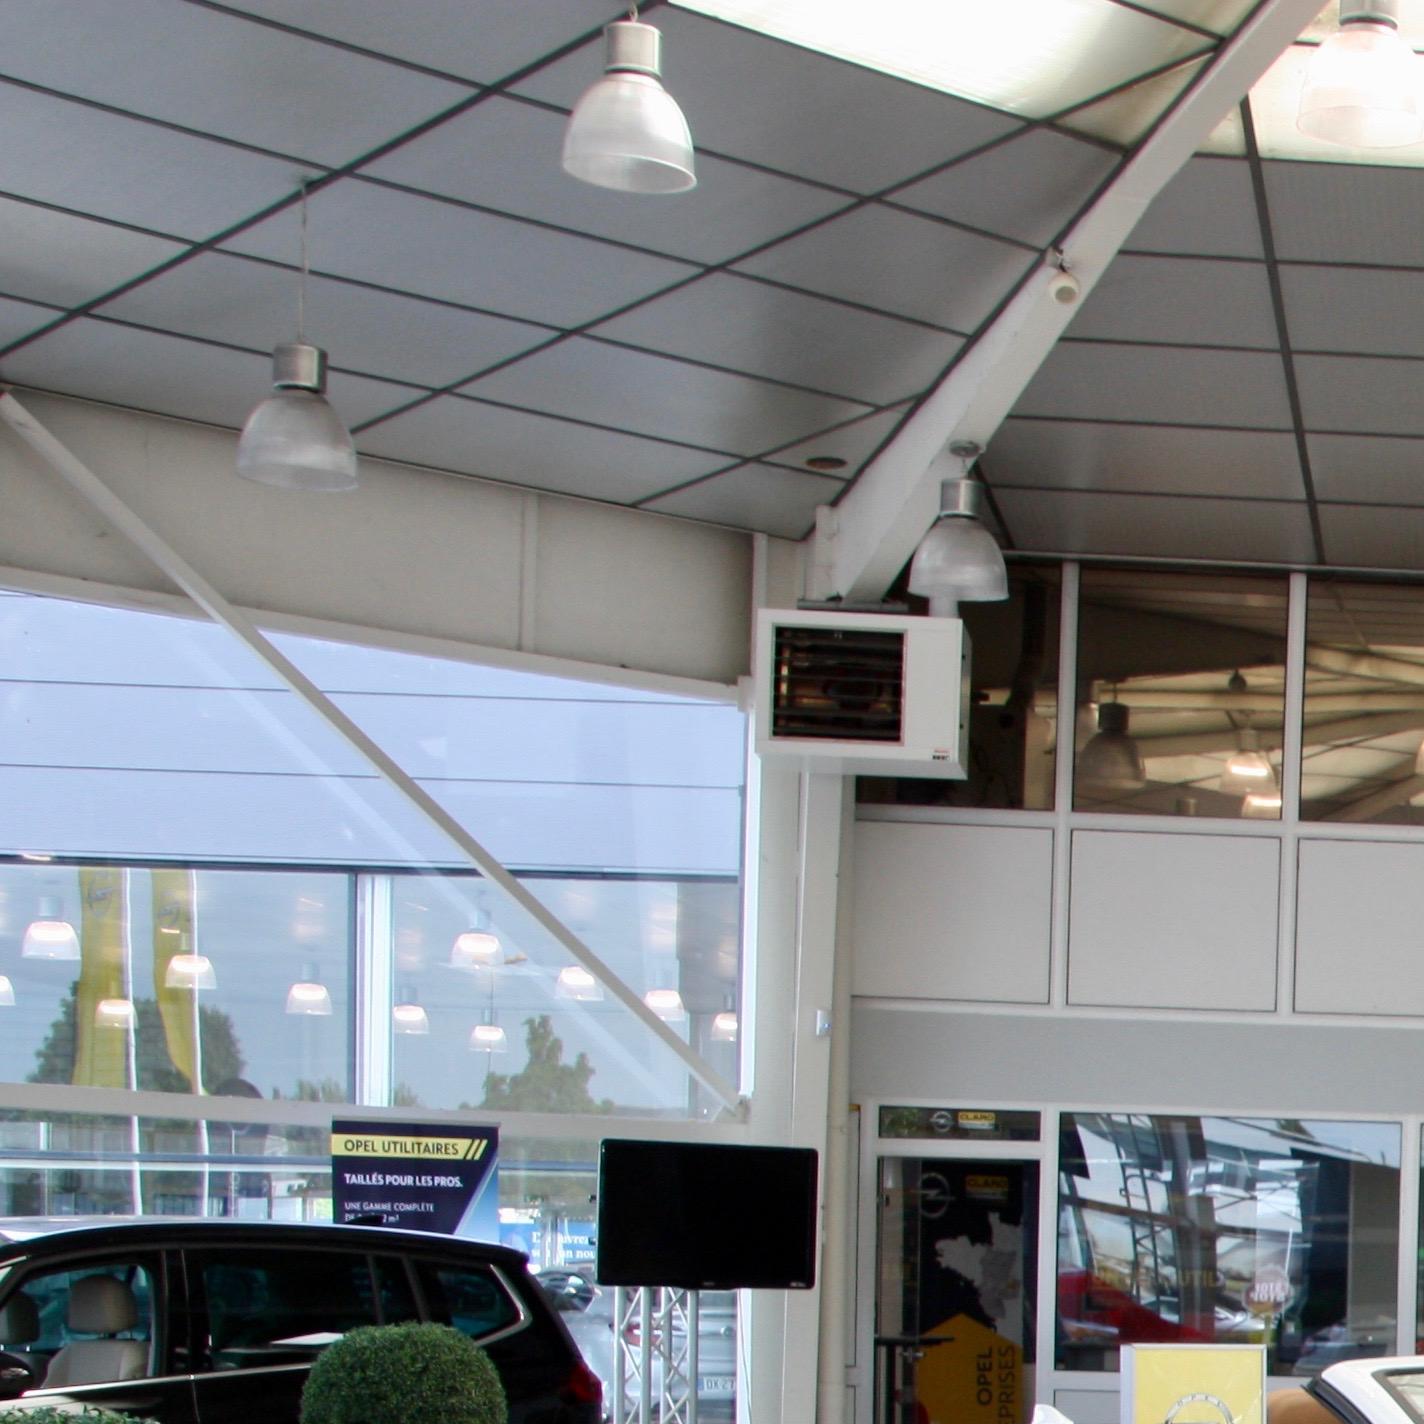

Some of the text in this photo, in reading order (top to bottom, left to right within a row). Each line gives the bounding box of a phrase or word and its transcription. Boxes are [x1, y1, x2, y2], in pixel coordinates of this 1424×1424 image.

[344, 1139, 460, 1156] OPEL UTILITAIRES
[344, 1172, 464, 1188] TAILLÉS POUR LES PROS.
